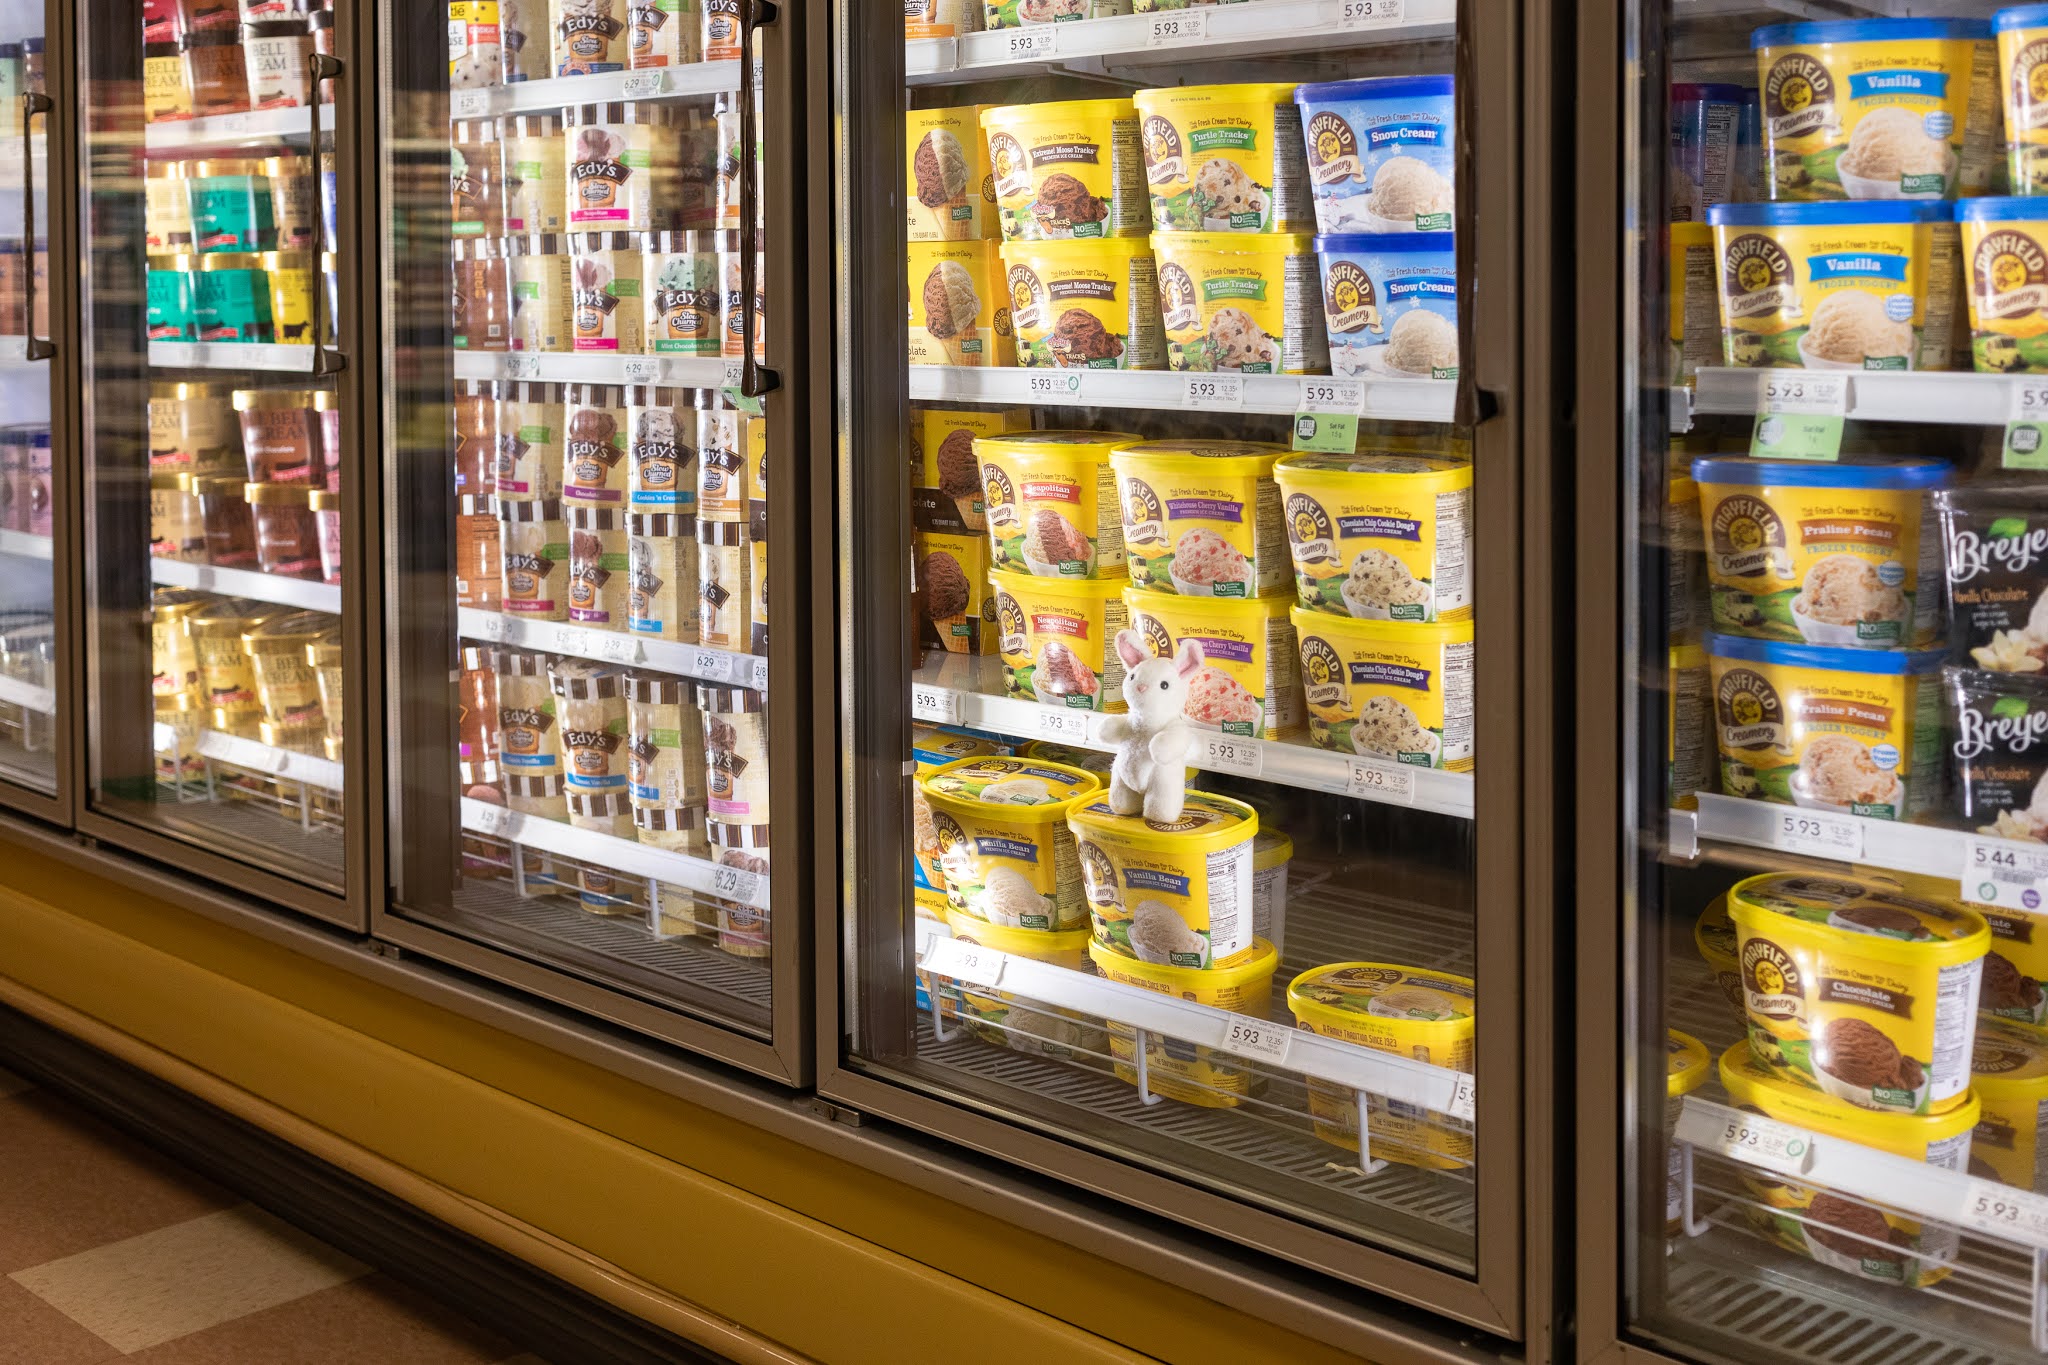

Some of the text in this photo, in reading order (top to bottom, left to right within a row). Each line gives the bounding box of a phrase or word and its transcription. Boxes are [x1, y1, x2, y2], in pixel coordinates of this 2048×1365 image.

[1345, 2, 1373, 17] 5.93
[566, 17, 608, 31] Edy's
[1154, 22, 1179, 36] 5.93
[1011, 38, 1033, 50] 5.93
[1767, 57, 1828, 96] MAYFIELD
[1867, 75, 1921, 89] Vanilla
[1197, 117, 1252, 128] Fresh Cream Dairy
[1377, 113, 1441, 124] Fresh Cream Dairy
[1192, 129, 1249, 142] Turtle Tracks
[1309, 114, 1351, 148] MAYFIELD
[1371, 128, 1435, 142] Snow Cream
[1032, 145, 1095, 158] Extreme! Moose Tracks
[577, 163, 616, 177] Edy's
[1903, 177, 1920, 188] NO
[1231, 215, 1243, 224] NO
[1418, 216, 1430, 226] NO
[1726, 238, 1786, 274] MAYFIELD
[1975, 238, 2044, 272] MAYFIELD
[1826, 258, 1881, 272] Vanilla
[1008, 265, 1039, 292] MAYFIELD
[1206, 280, 1259, 290] Turtle Tracks
[1326, 264, 1370, 297] MAYFIELD
[1051, 282, 1112, 292] Extreme! Moose Tracks
[1390, 281, 1454, 293] Snow Cream
[665, 290, 708, 306] Edy's
[1066, 352, 1086, 361] TRACKS
[1433, 370, 1446, 379] NO
[1031, 378, 1051, 390] 5.93
[1190, 383, 1215, 396] 5.93
[1766, 383, 1803, 397] 5.93
[1306, 387, 1334, 400] 5.93
[572, 442, 607, 458] Edy's
[638, 442, 678, 460] Edy's
[1027, 484, 1070, 494] Neapolitan
[1197, 501, 1216, 512] Cherry
[1217, 503, 1239, 512] Vanilla
[1287, 495, 1326, 527] MAYFIELD
[1350, 505, 1412, 519] Fresh Cream Dairy
[1340, 519, 1415, 532] Chocolate Chip Cookie Dough
[1714, 500, 1778, 542] MAYFIELD
[1803, 525, 1892, 539] Praline Pecan
[1951, 525, 2048, 583] Breye
[506, 555, 539, 571] Edy's
[1982, 587, 2029, 602] Chocolate
[1391, 605, 1404, 615] NO
[1036, 617, 1078, 628] Neapolitan
[1209, 641, 1249, 652] Cherry Vanilla
[1301, 638, 1339, 672] MAYFIELD
[1352, 665, 1424, 680] Chocolate Chip Cookie Dough
[1722, 672, 1777, 709] MAYFIELD
[917, 694, 936, 707] 5.93
[503, 708, 539, 725] Edy's
[1848, 707, 1886, 722] Pecan
[569, 732, 605, 747] Edy's
[1954, 708, 2048, 758] Breye
[1209, 744, 1234, 758] 5.93
[1355, 768, 1383, 785] 5.93
[1983, 769, 2031, 782] Chocolate
[1853, 805, 1869, 815] NO
[1784, 818, 1820, 837] 5.93
[980, 838, 1030, 853] Vanilla Bean
[1975, 848, 2016, 867] 5.44
[1130, 859, 1185, 876] Fresh Cream Dairy
[1208, 868, 1226, 876] Calories
[1127, 870, 1181, 886] Vanilla Bean
[1172, 953, 1182, 963] NO
[1743, 943, 1798, 983] MAYFIELD
[1832, 981, 1891, 1002] Chocolate
[1232, 1026, 1259, 1043] 5.93
[1384, 1036, 1397, 1048] 1923
[1873, 1087, 1890, 1099] NO
[1725, 1123, 1759, 1145] 5.93
[1975, 1196, 2019, 1221] 5.93
